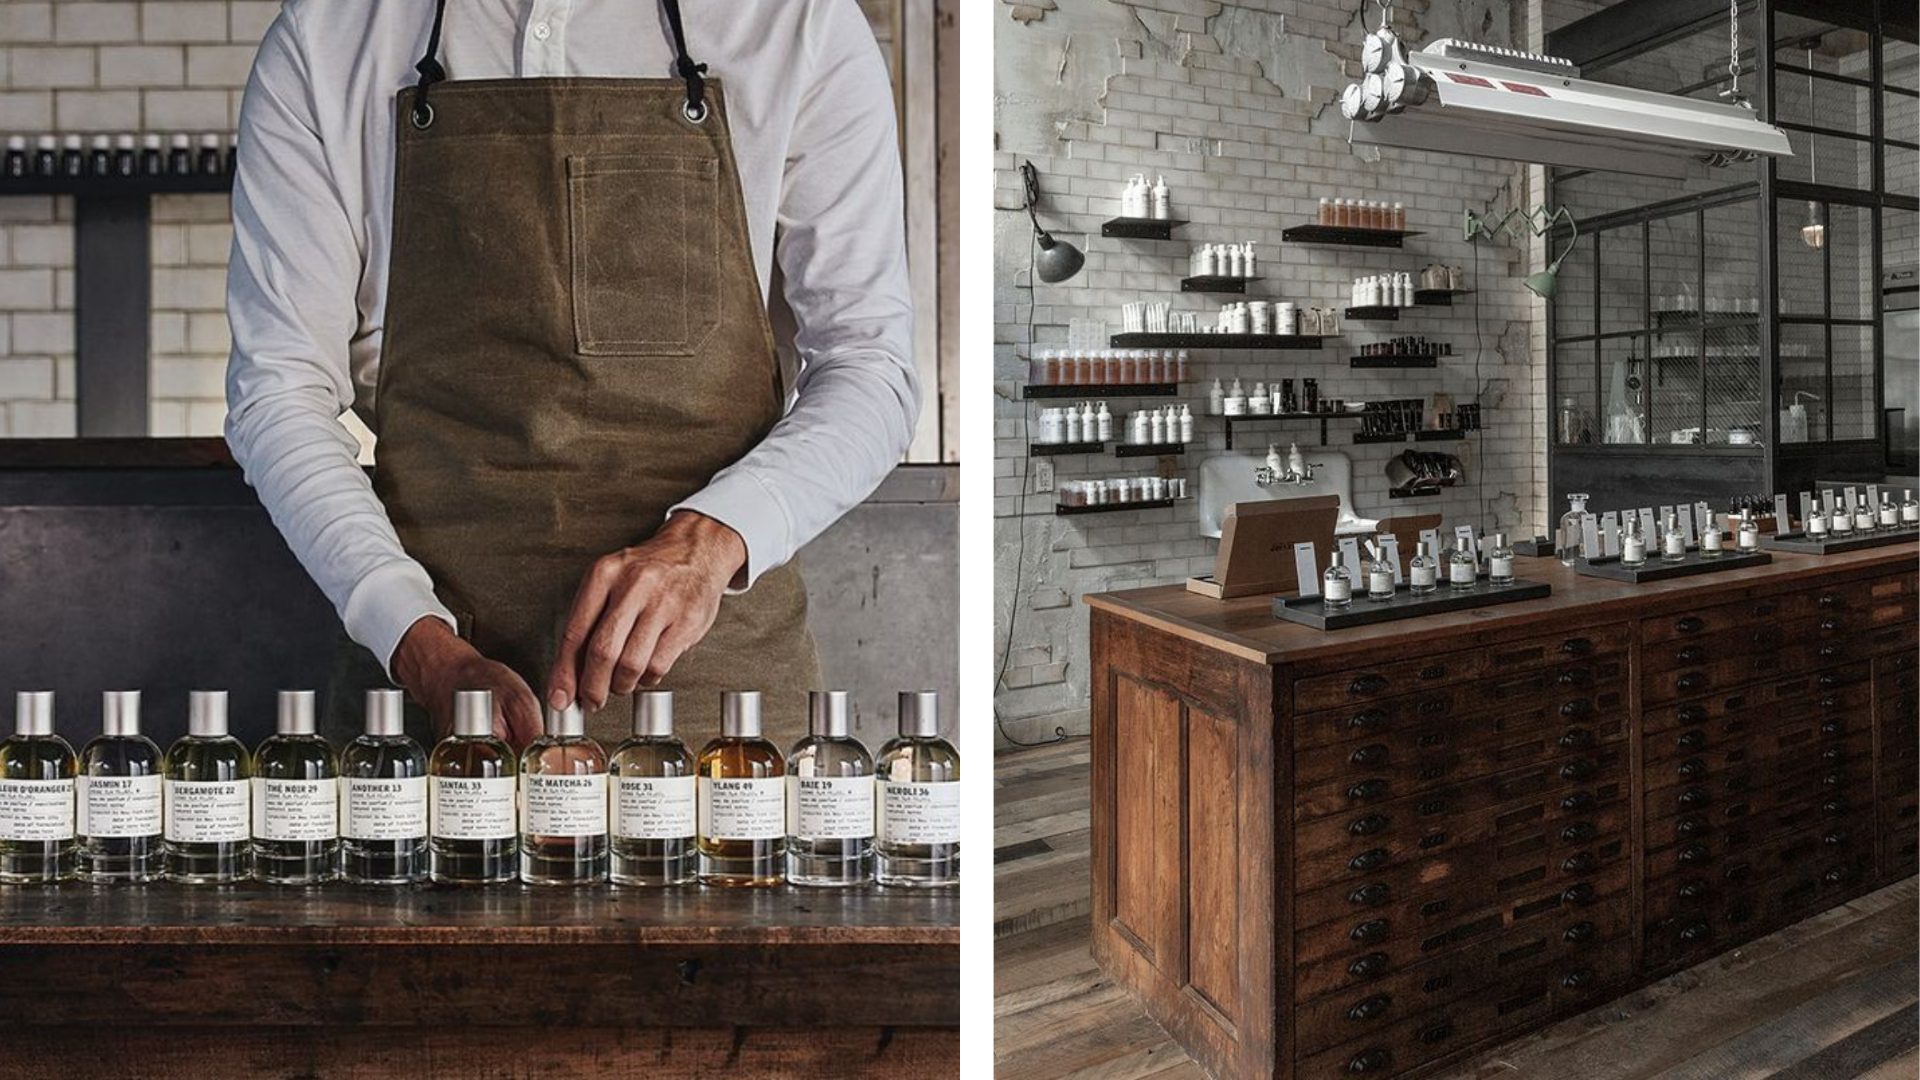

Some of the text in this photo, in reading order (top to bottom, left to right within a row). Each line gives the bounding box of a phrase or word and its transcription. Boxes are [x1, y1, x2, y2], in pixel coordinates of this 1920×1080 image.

[122, 780, 132, 788] 17
[440, 781, 482, 790] SANTAL 33
[546, 779, 581, 787] MATCHA
[621, 782, 641, 790] ROSE
[713, 782, 753, 790] YLANG 49
[801, 781, 832, 789] BAIE 19
[20, 785, 65, 793] D'ORANGER
[175, 787, 223, 795] BERGAMOTE
[267, 784, 317, 793] THÉ NOIR 29
[352, 784, 402, 792] ANOTHER 13
[887, 787, 917, 795] NEROLI
